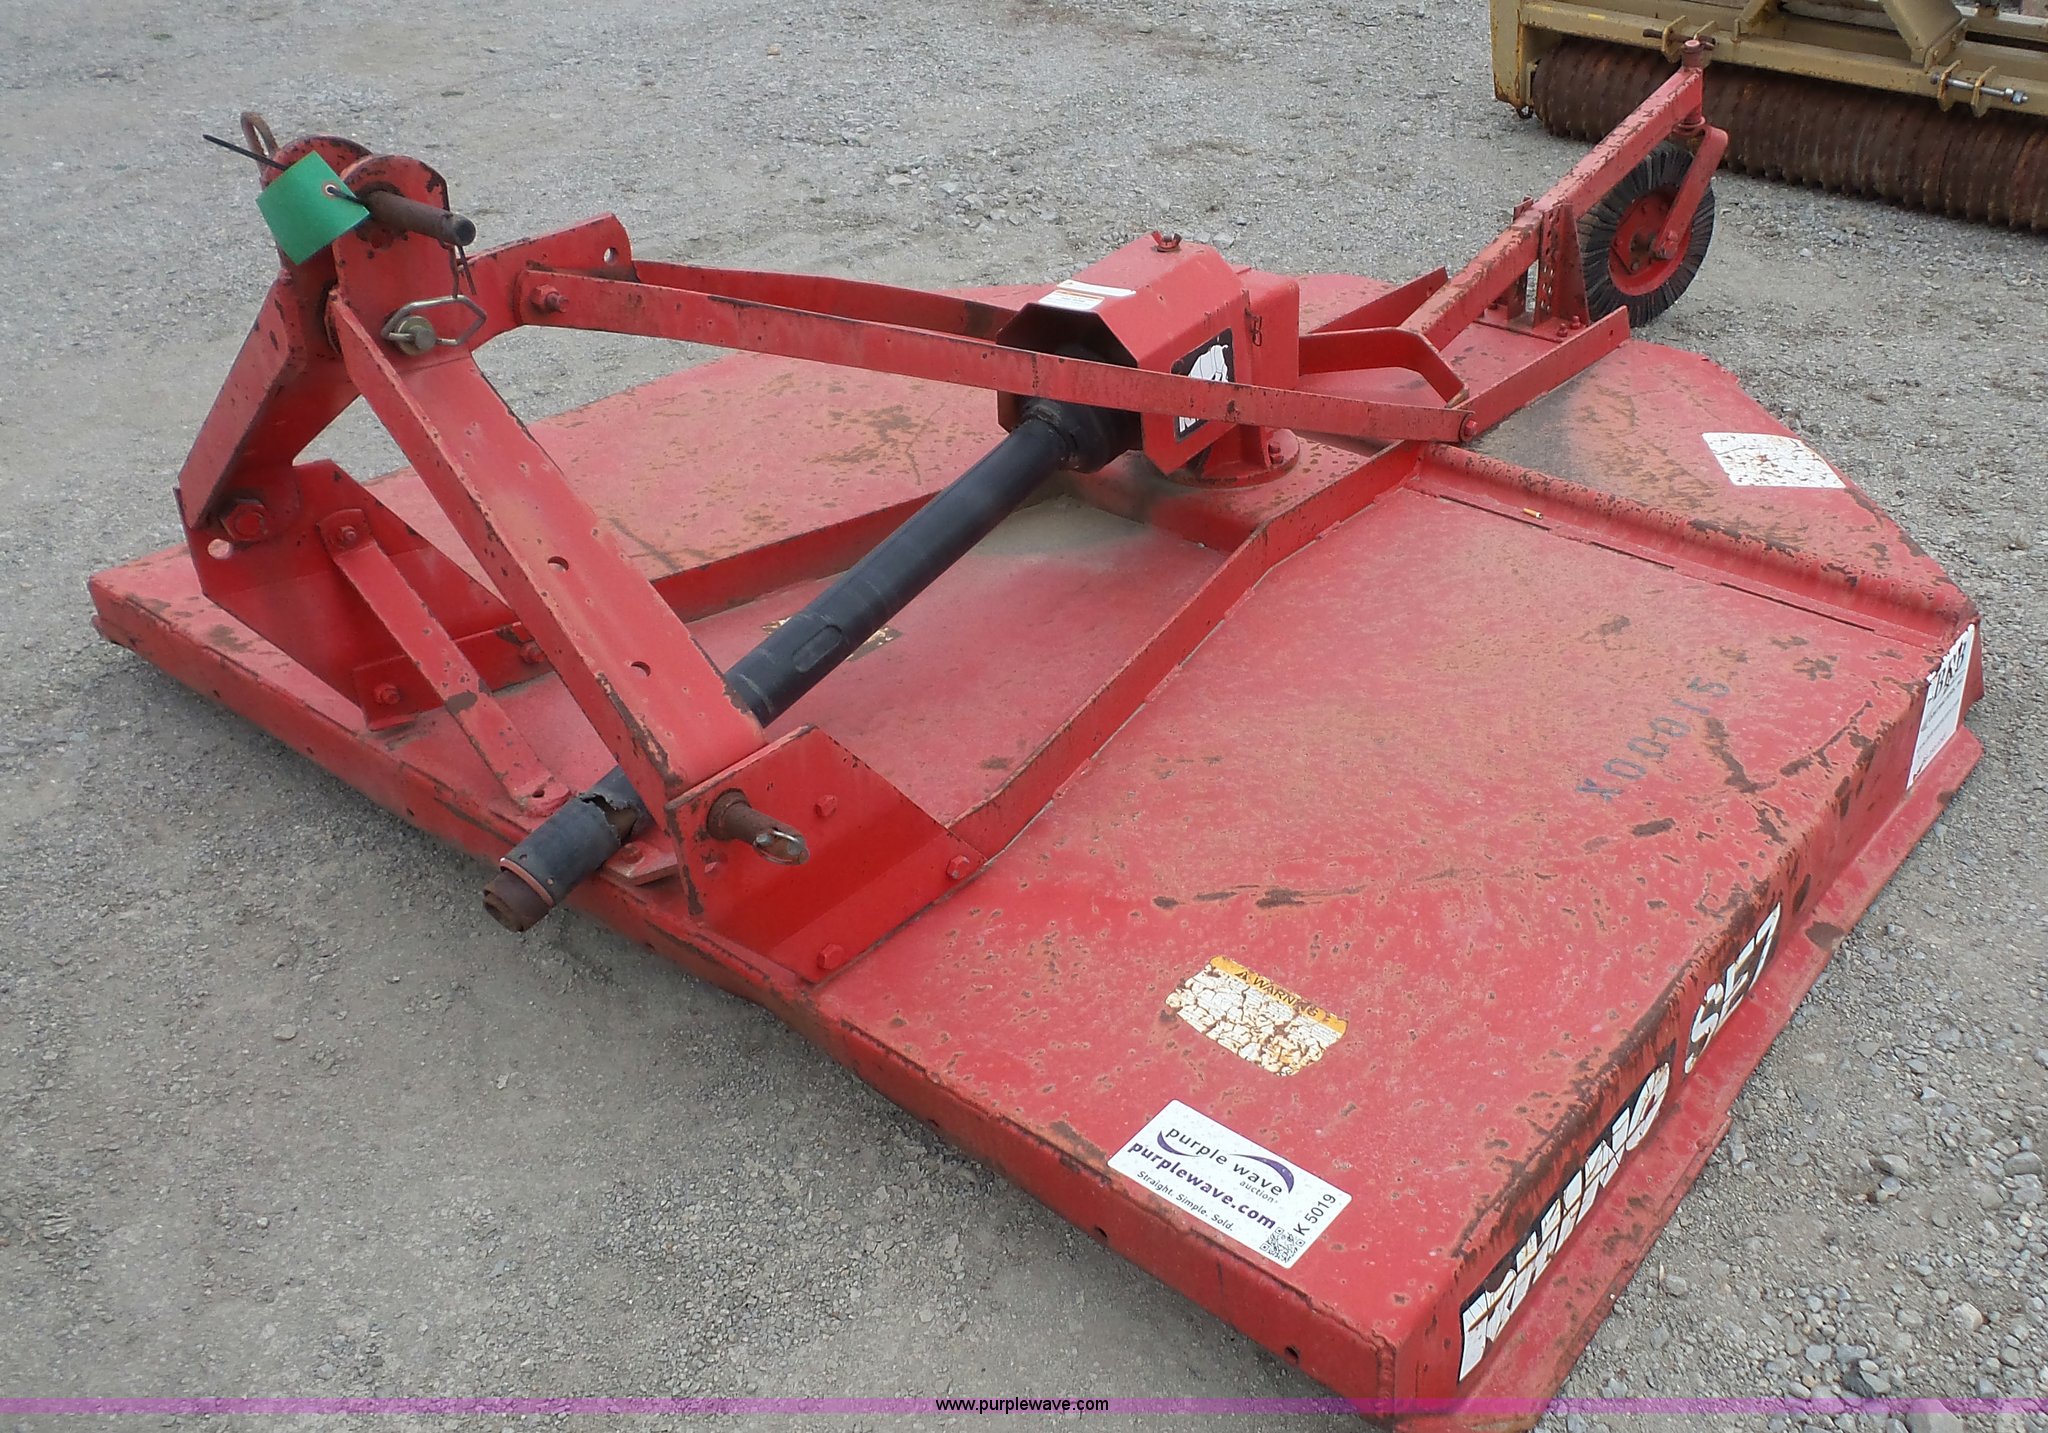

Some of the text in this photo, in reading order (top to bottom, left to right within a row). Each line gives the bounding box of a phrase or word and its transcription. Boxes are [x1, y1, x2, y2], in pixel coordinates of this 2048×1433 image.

[1127, 1141, 1277, 1230] purplewave.com
[1164, 1127, 1283, 1197] purple wave
[1239, 1180, 1275, 1203] auction
[1137, 1170, 1234, 1232] Straight. Simple. Sold.
[1293, 1193, 1337, 1236] K 5019
[1459, 1062, 1671, 1381] RHINO
